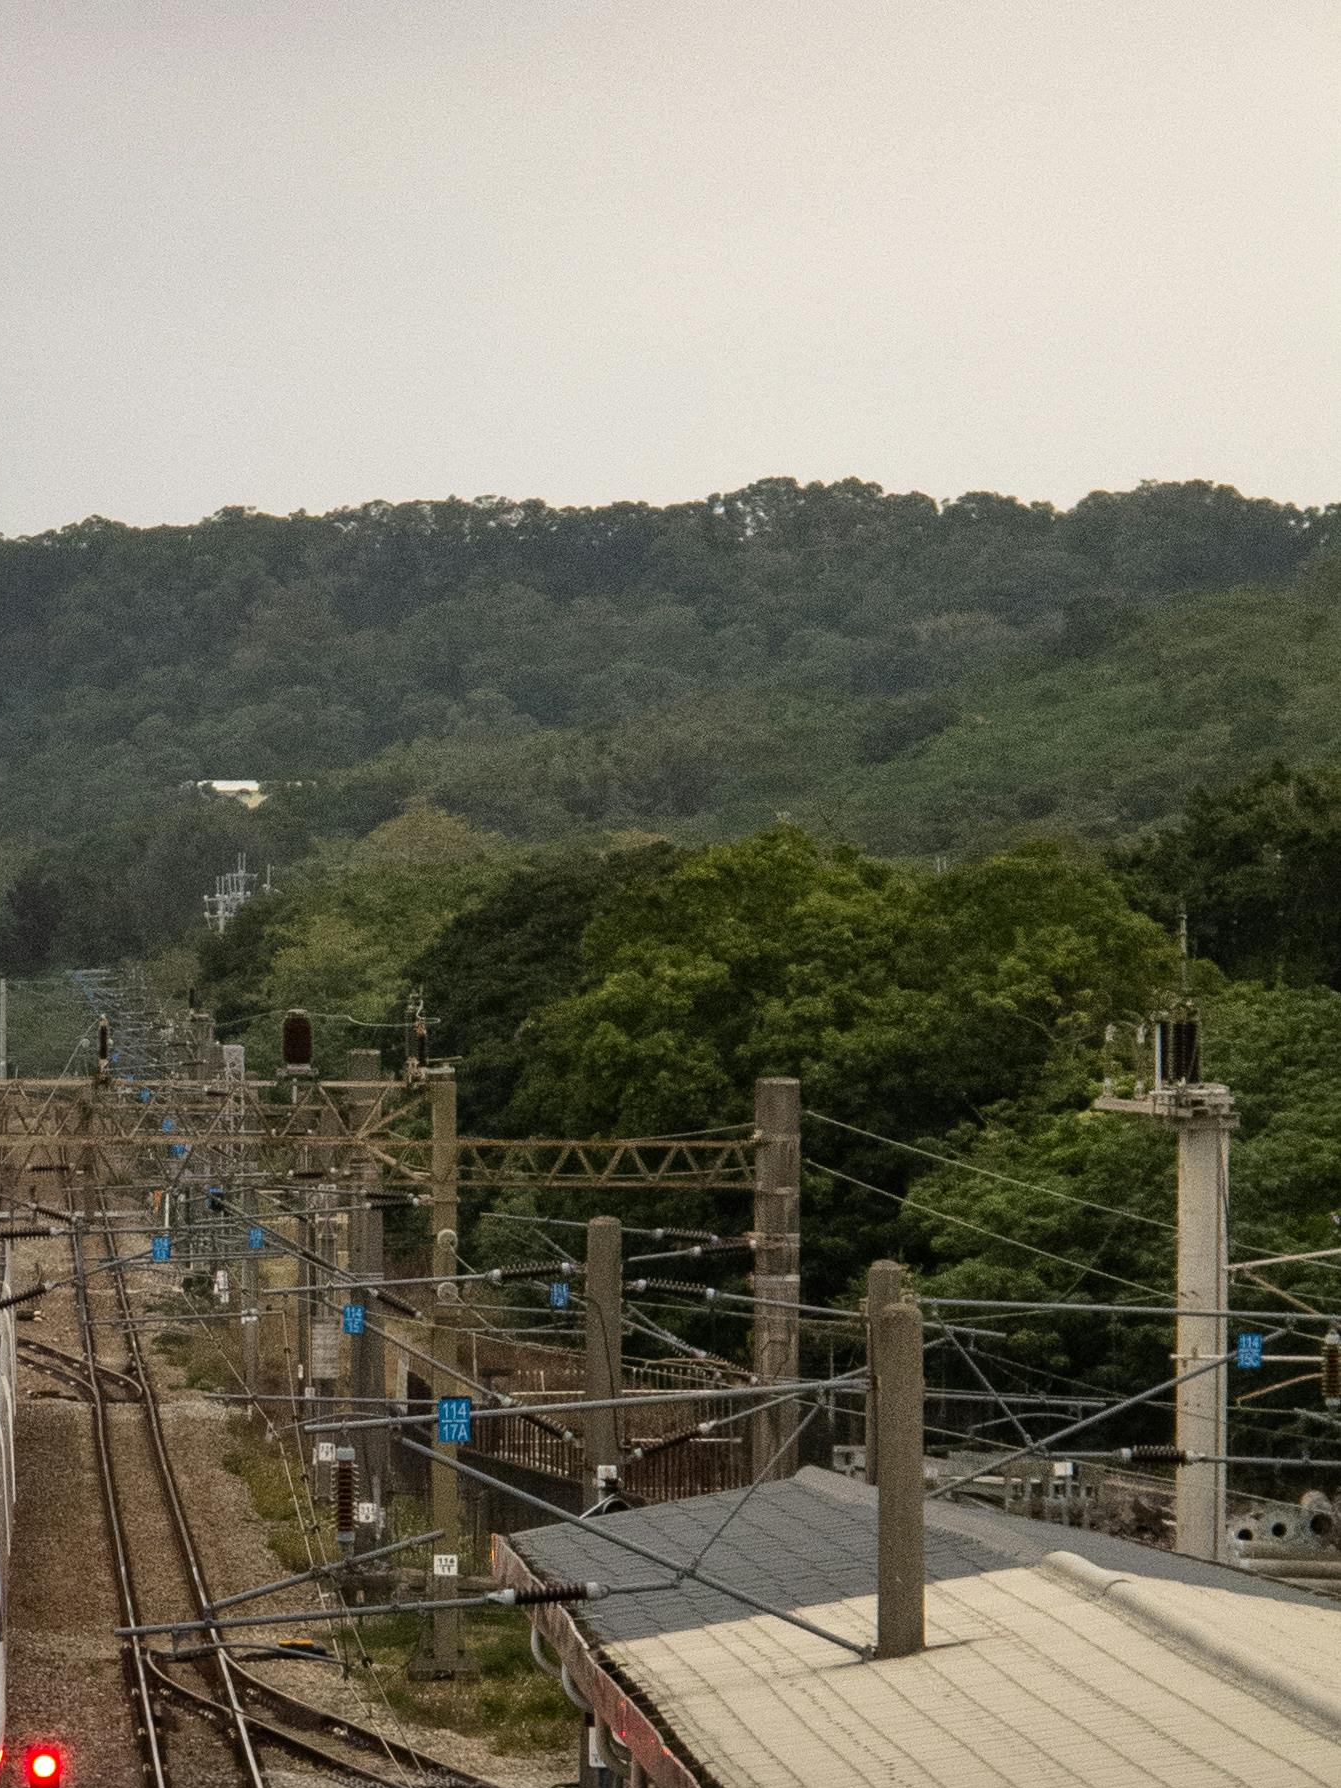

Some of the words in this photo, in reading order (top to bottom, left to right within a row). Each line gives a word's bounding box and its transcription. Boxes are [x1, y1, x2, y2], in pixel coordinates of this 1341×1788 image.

[345, 1306, 362, 1318] 114
[1240, 1335, 1260, 1349] 114
[442, 1402, 467, 1418] 114
[442, 1424, 468, 1441] 17A
